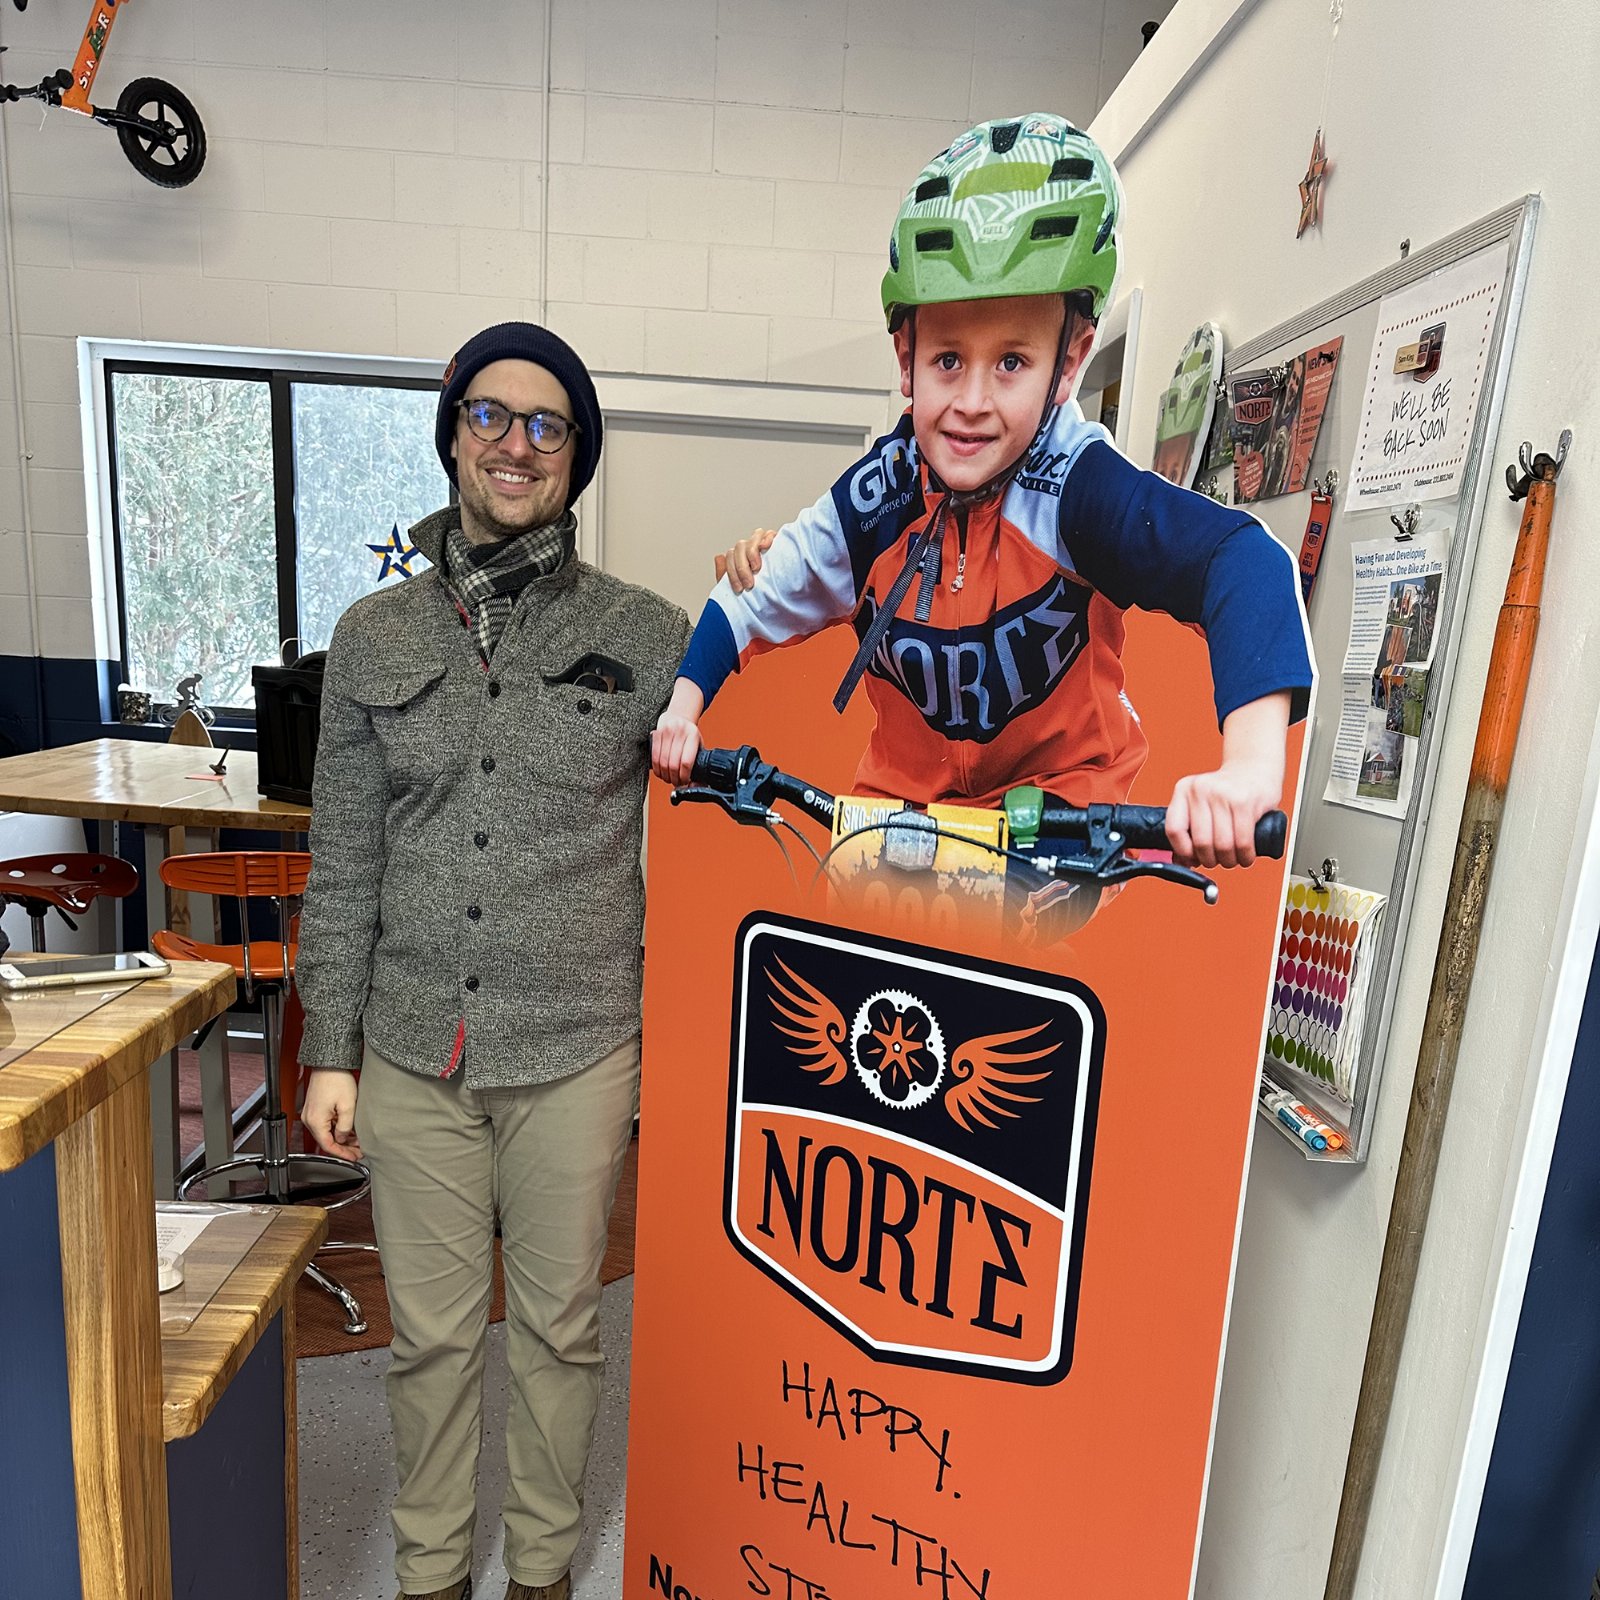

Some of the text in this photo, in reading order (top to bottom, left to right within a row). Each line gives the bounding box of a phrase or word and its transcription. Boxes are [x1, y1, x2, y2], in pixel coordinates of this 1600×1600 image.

[1238, 400, 1271, 420] NORTE
[1391, 378, 1452, 422] WE'LL BE
[1383, 408, 1450, 460] BACK SOON
[1355, 547, 1427, 566] Having Fun and Developing
[1355, 567, 1376, 580] Healthy
[1408, 562, 1419, 573] Bike
[1420, 563, 1426, 573] at
[756, 1127, 1032, 1340] NORTE
[782, 1360, 961, 1499] HAPPY.
[737, 1441, 991, 1600] HEALTHY
